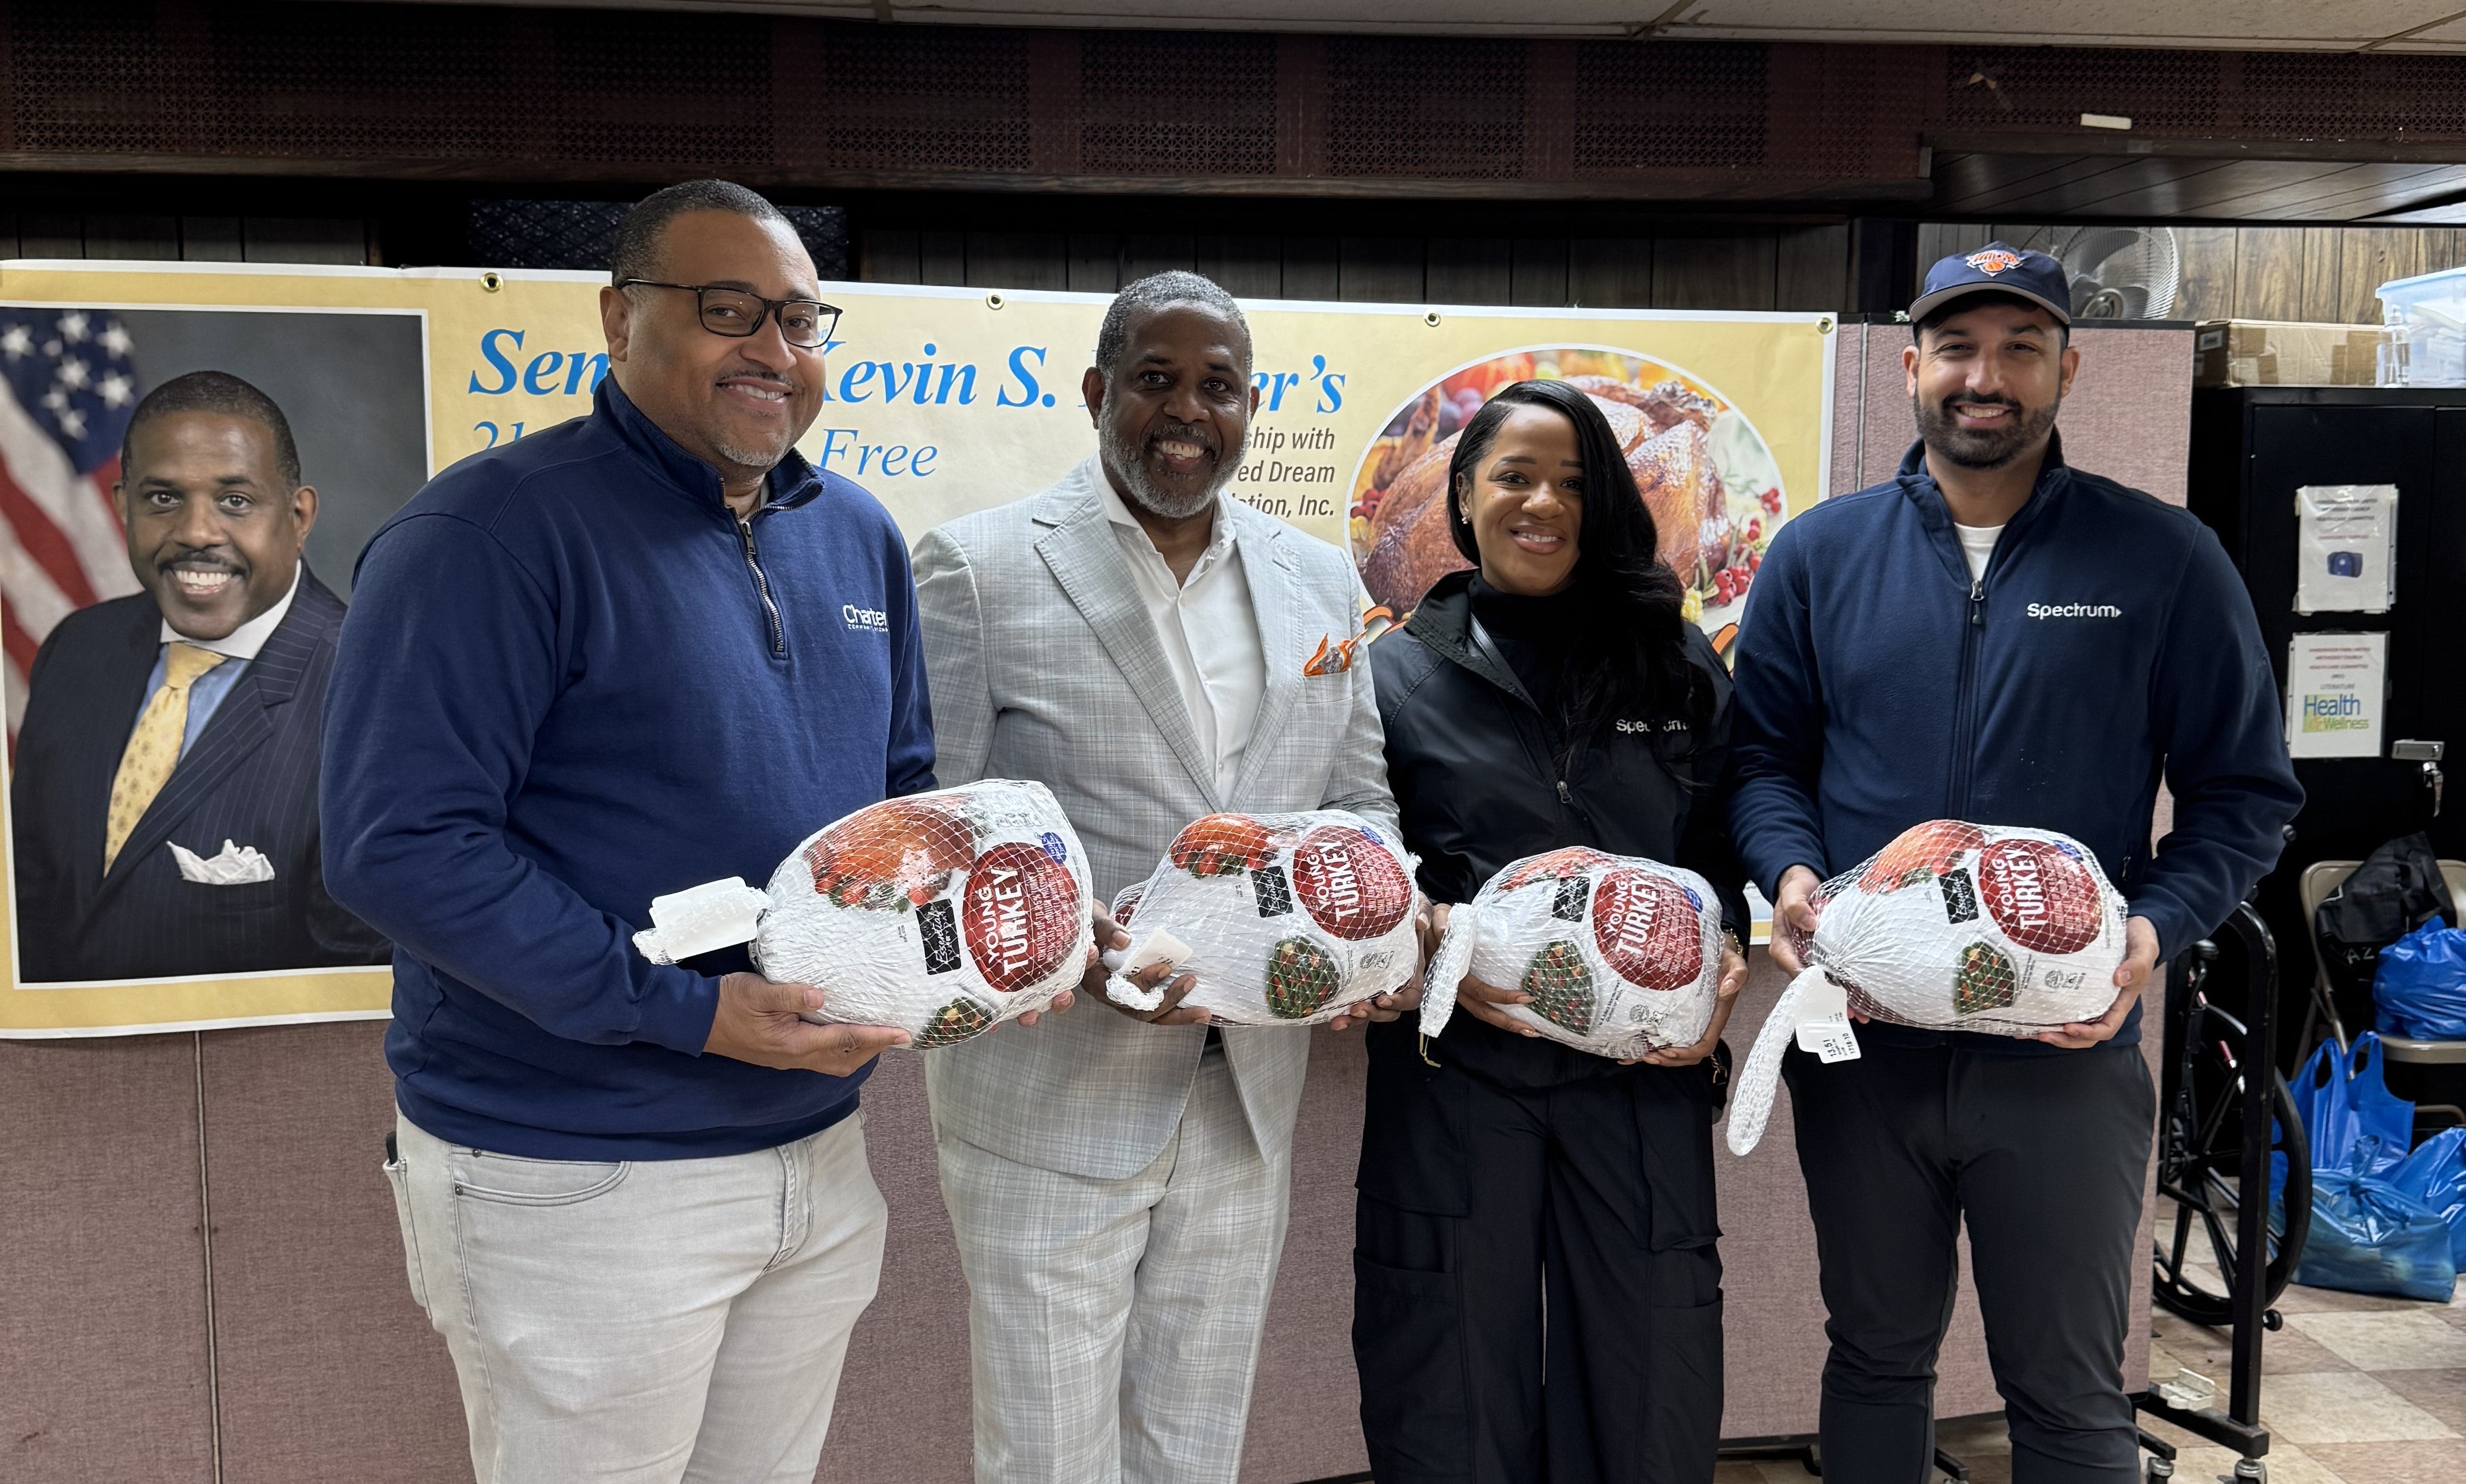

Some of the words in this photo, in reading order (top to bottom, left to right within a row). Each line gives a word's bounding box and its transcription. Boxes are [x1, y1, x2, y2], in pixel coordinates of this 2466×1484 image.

[468, 329, 609, 395] Sen
[997, 346, 1056, 408] S.
[820, 428, 938, 477] Free
[1292, 427, 1335, 450] with
[1268, 461, 1335, 483] Dream
[1299, 494, 1334, 516] Inc.
[2027, 602, 2115, 620] Spectrum
[2304, 694, 2360, 717] Health
[1306, 854, 1331, 911] YOUNG
[1315, 840, 1360, 922] TURKEY
[1604, 880, 1629, 934] YOUNG
[1991, 858, 2015, 918] YOUNG
[2002, 848, 2048, 930] TURKEY
[978, 885, 1000, 964] YOUNG
[990, 866, 1029, 976] TURKEY
[1615, 872, 1657, 956] TURKEY
